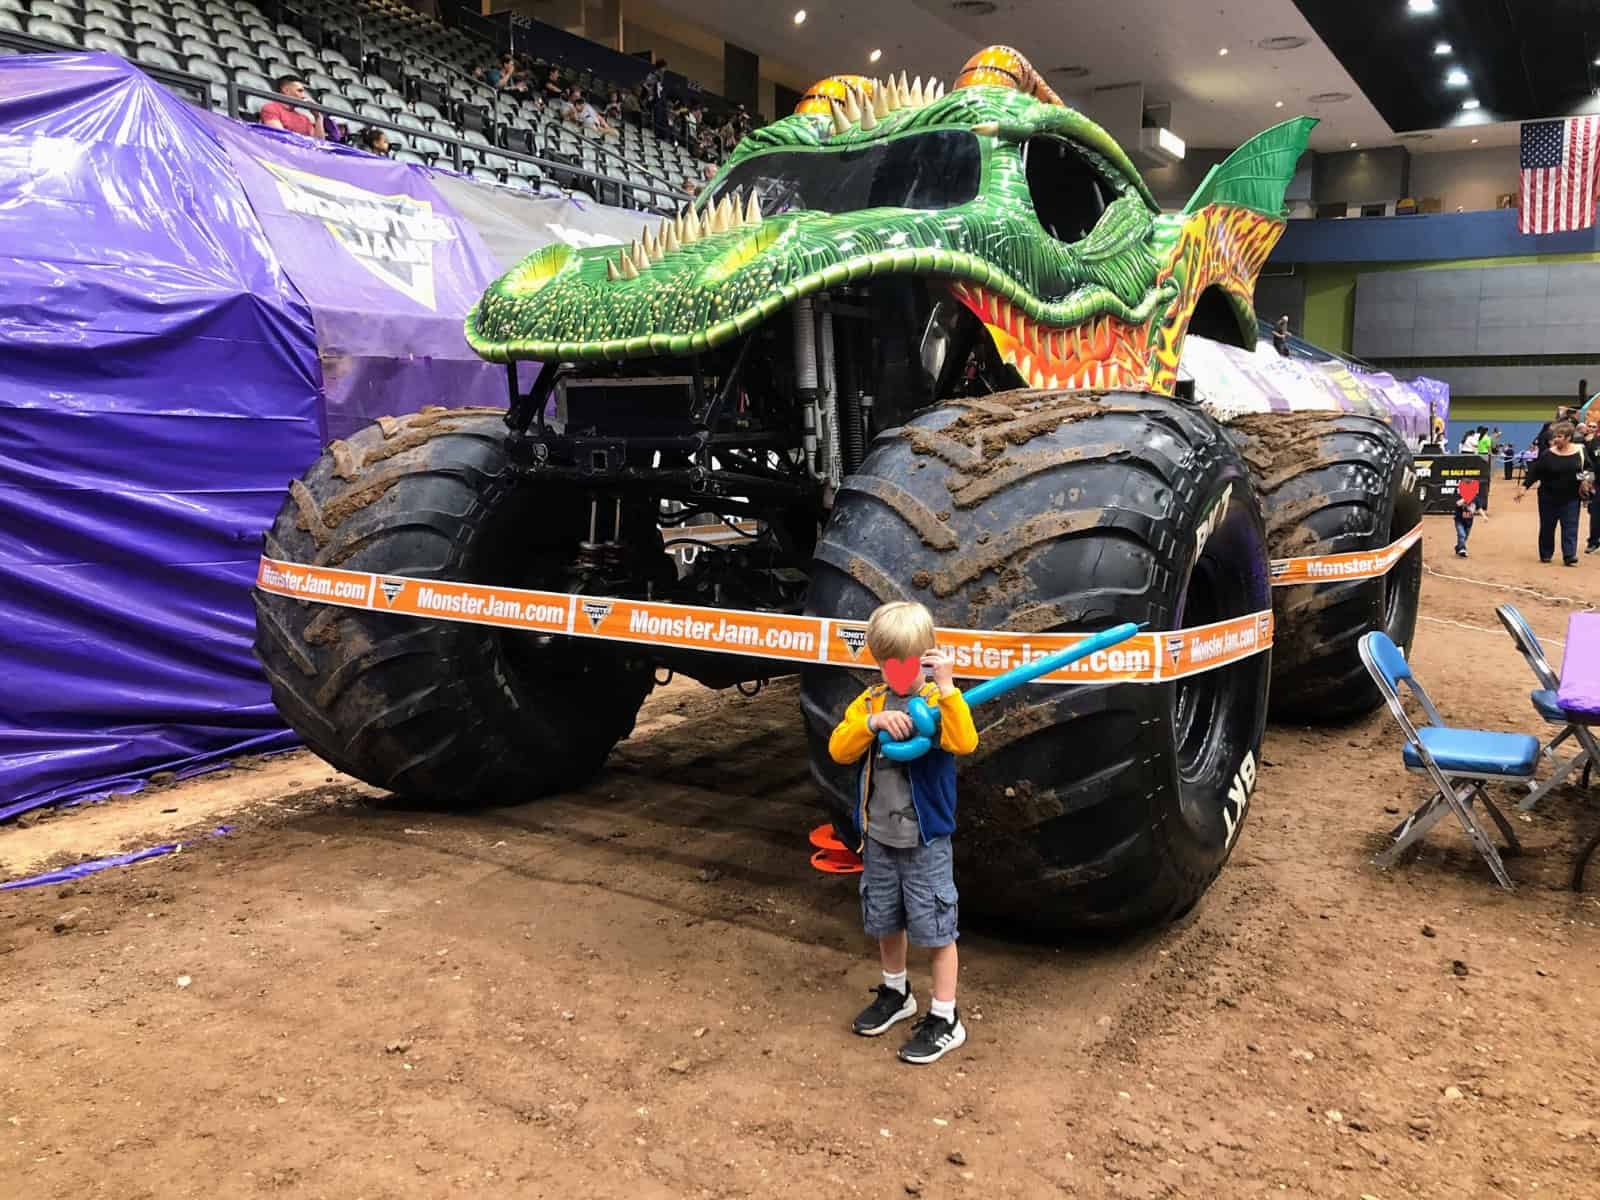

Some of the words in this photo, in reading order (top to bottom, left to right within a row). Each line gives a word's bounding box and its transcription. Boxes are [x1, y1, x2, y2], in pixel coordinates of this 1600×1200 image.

[263, 565, 366, 600] MonsterJam.com
[417, 587, 564, 625] MonsterJam.com
[629, 609, 814, 652] MonsterJam.com
[1191, 628, 1256, 663] MonsterJam.com
[1223, 749, 1256, 849] BKT
